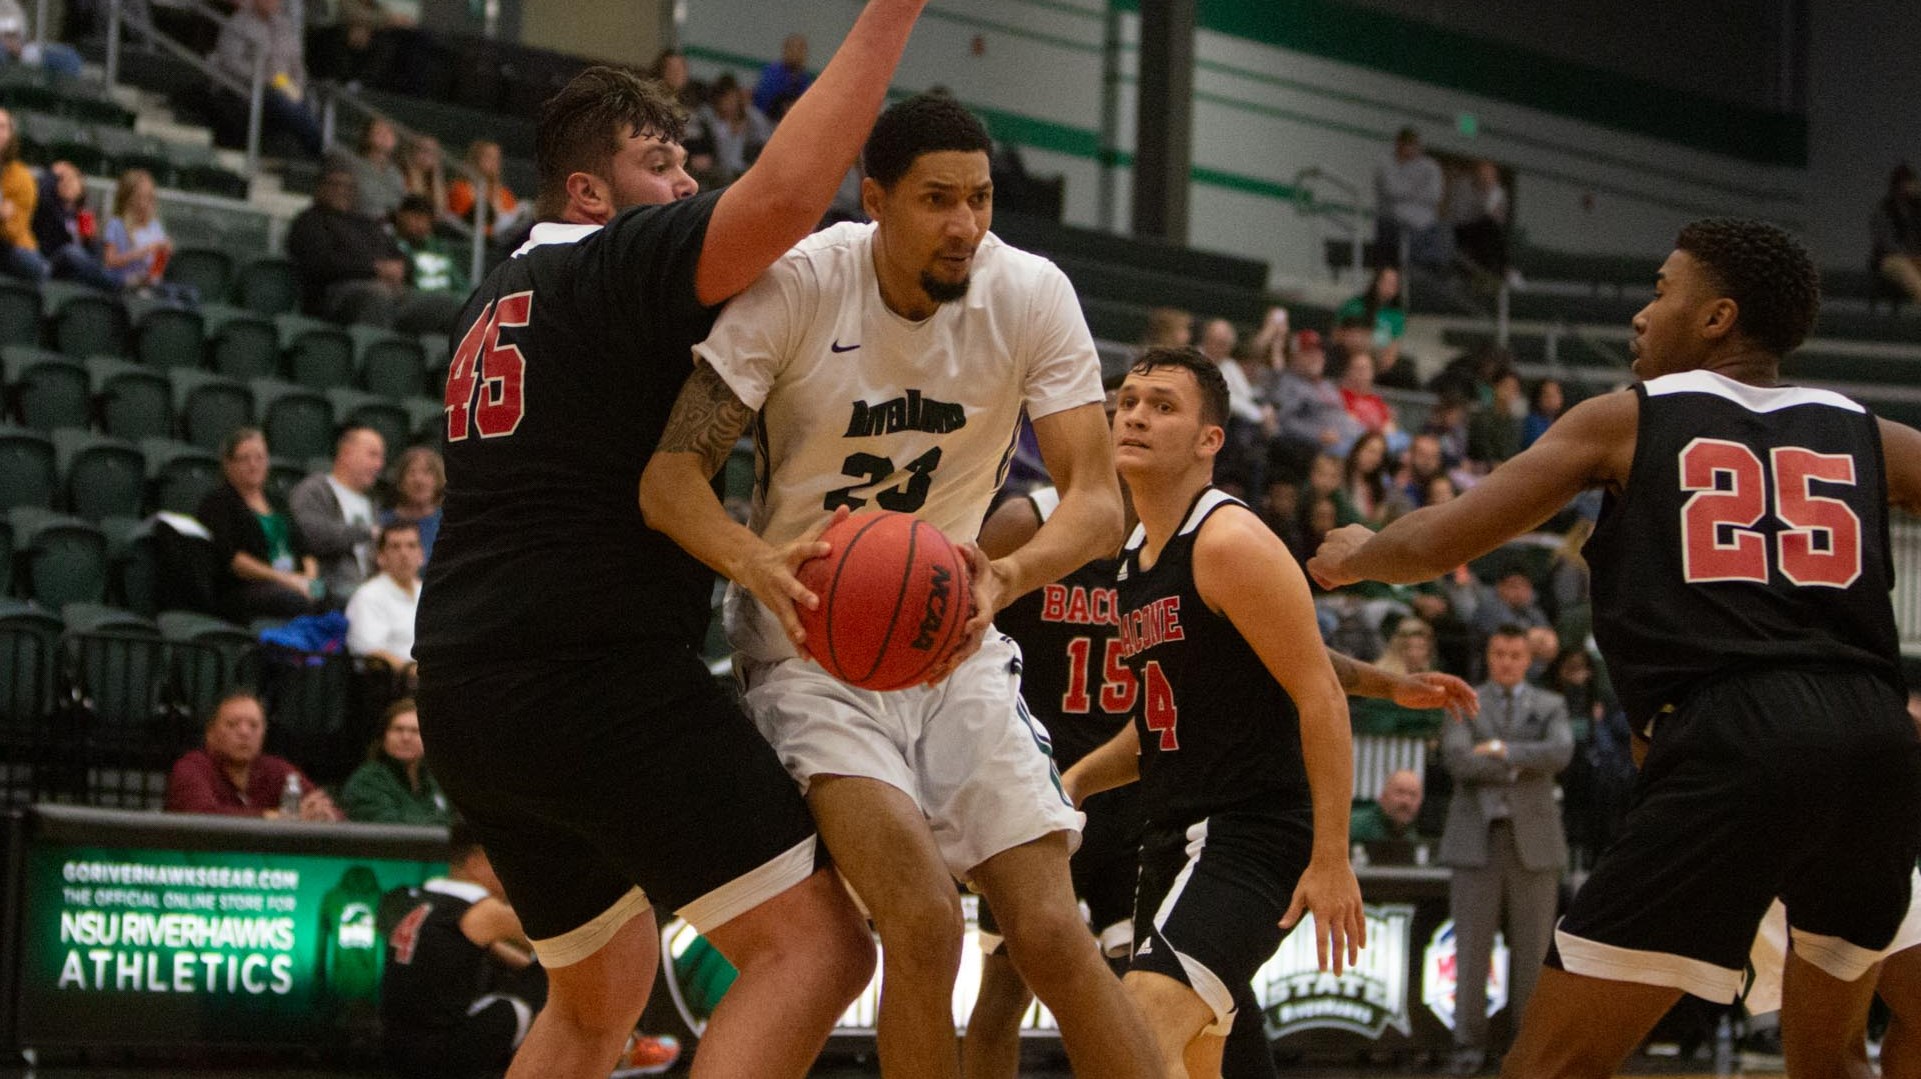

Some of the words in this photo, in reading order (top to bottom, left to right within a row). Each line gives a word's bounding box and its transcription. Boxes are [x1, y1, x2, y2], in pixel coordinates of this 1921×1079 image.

[444, 290, 534, 443] 45
[823, 445, 943, 514] 23
[1678, 436, 1863, 590] 25
[912, 564, 951, 653] NCAA
[1117, 595, 1186, 661] ACONE
[1061, 636, 1140, 715] 15
[62, 861, 299, 891] GORIVERHAWKSGEAR.COM
[64, 887, 92, 906] THE
[94, 888, 159, 909] OFFICIAL
[162, 891, 216, 911] ONLINE
[219, 893, 263, 912] STORE
[266, 895, 297, 912] FOR
[61, 910, 120, 946] NSU
[121, 911, 296, 951] RIVERHAWKS
[58, 949, 293, 994] ATHLETICS
[1268, 970, 1387, 1007] STATE
